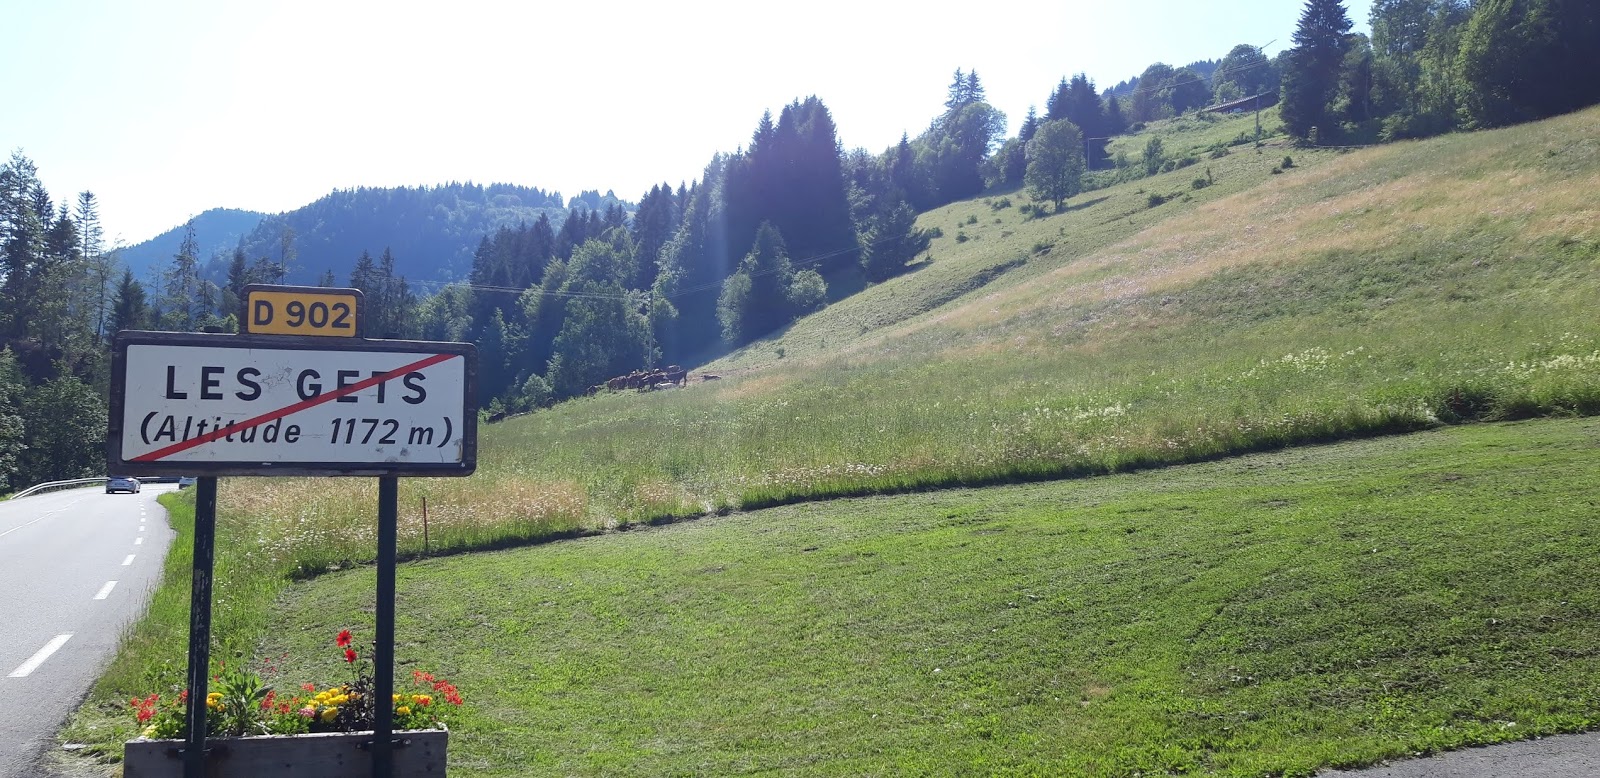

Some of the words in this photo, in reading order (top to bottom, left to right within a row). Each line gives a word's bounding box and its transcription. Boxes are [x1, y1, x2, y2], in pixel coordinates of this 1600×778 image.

[254, 300, 274, 326] D
[286, 301, 351, 328] 902
[166, 365, 262, 401] LES
[296, 368, 427, 405] GETS
[140, 411, 301, 445] (Altitude
[330, 417, 399, 445] 1172
[408, 417, 453, 448] m)
